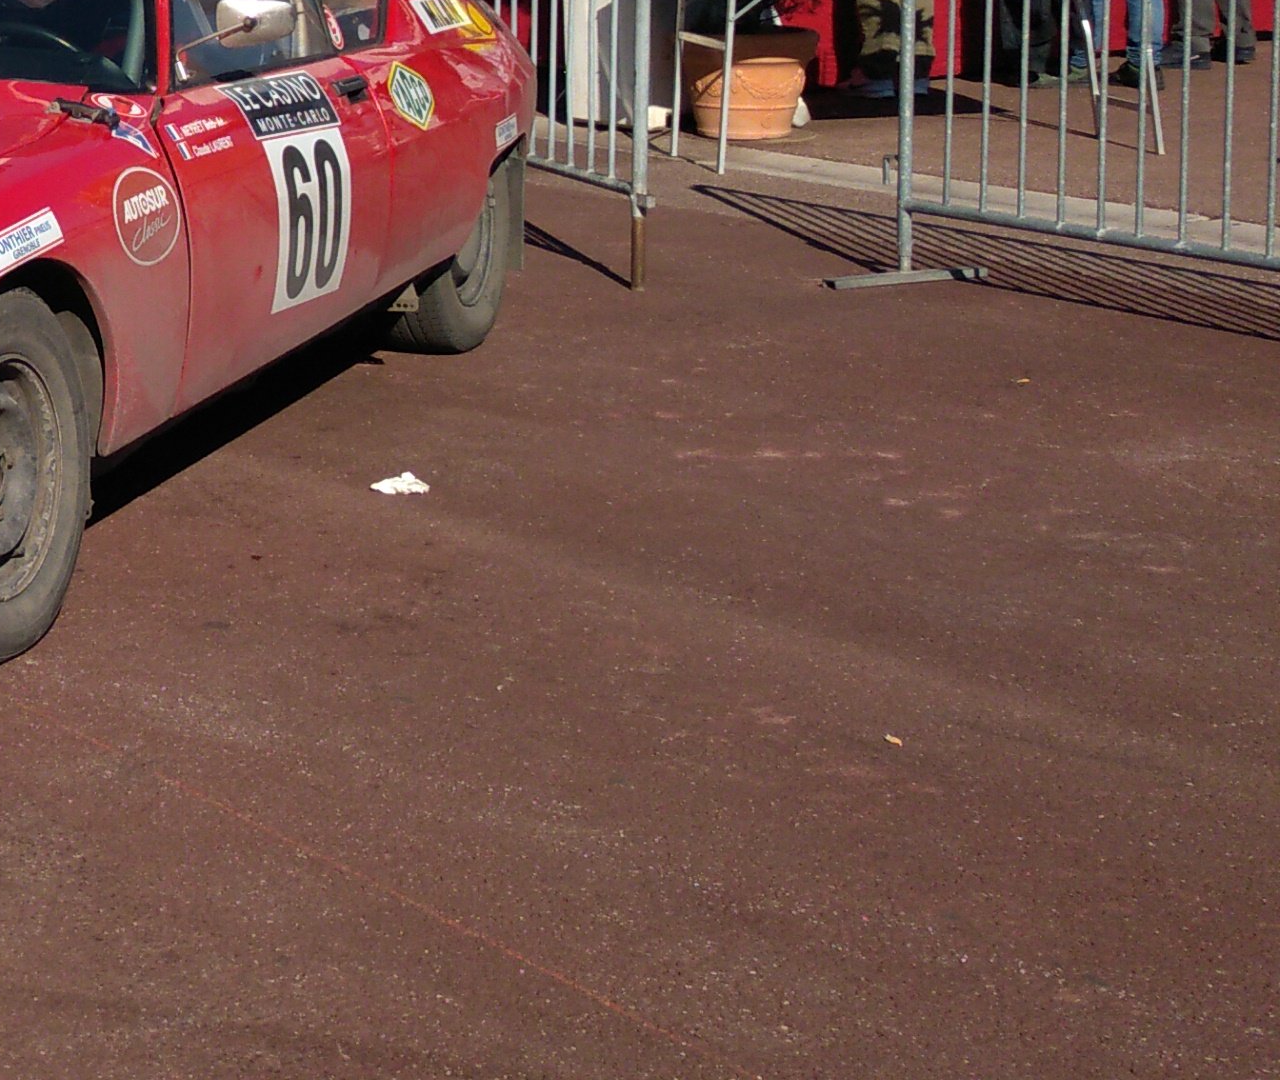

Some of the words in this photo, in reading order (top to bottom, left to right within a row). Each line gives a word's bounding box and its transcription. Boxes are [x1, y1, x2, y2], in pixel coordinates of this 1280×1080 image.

[225, 85, 261, 111] LE
[255, 75, 321, 108] CASINO
[123, 185, 170, 224] AUTOSUR
[282, 138, 342, 300] 60
[13, 238, 41, 260] GRENOBLE
